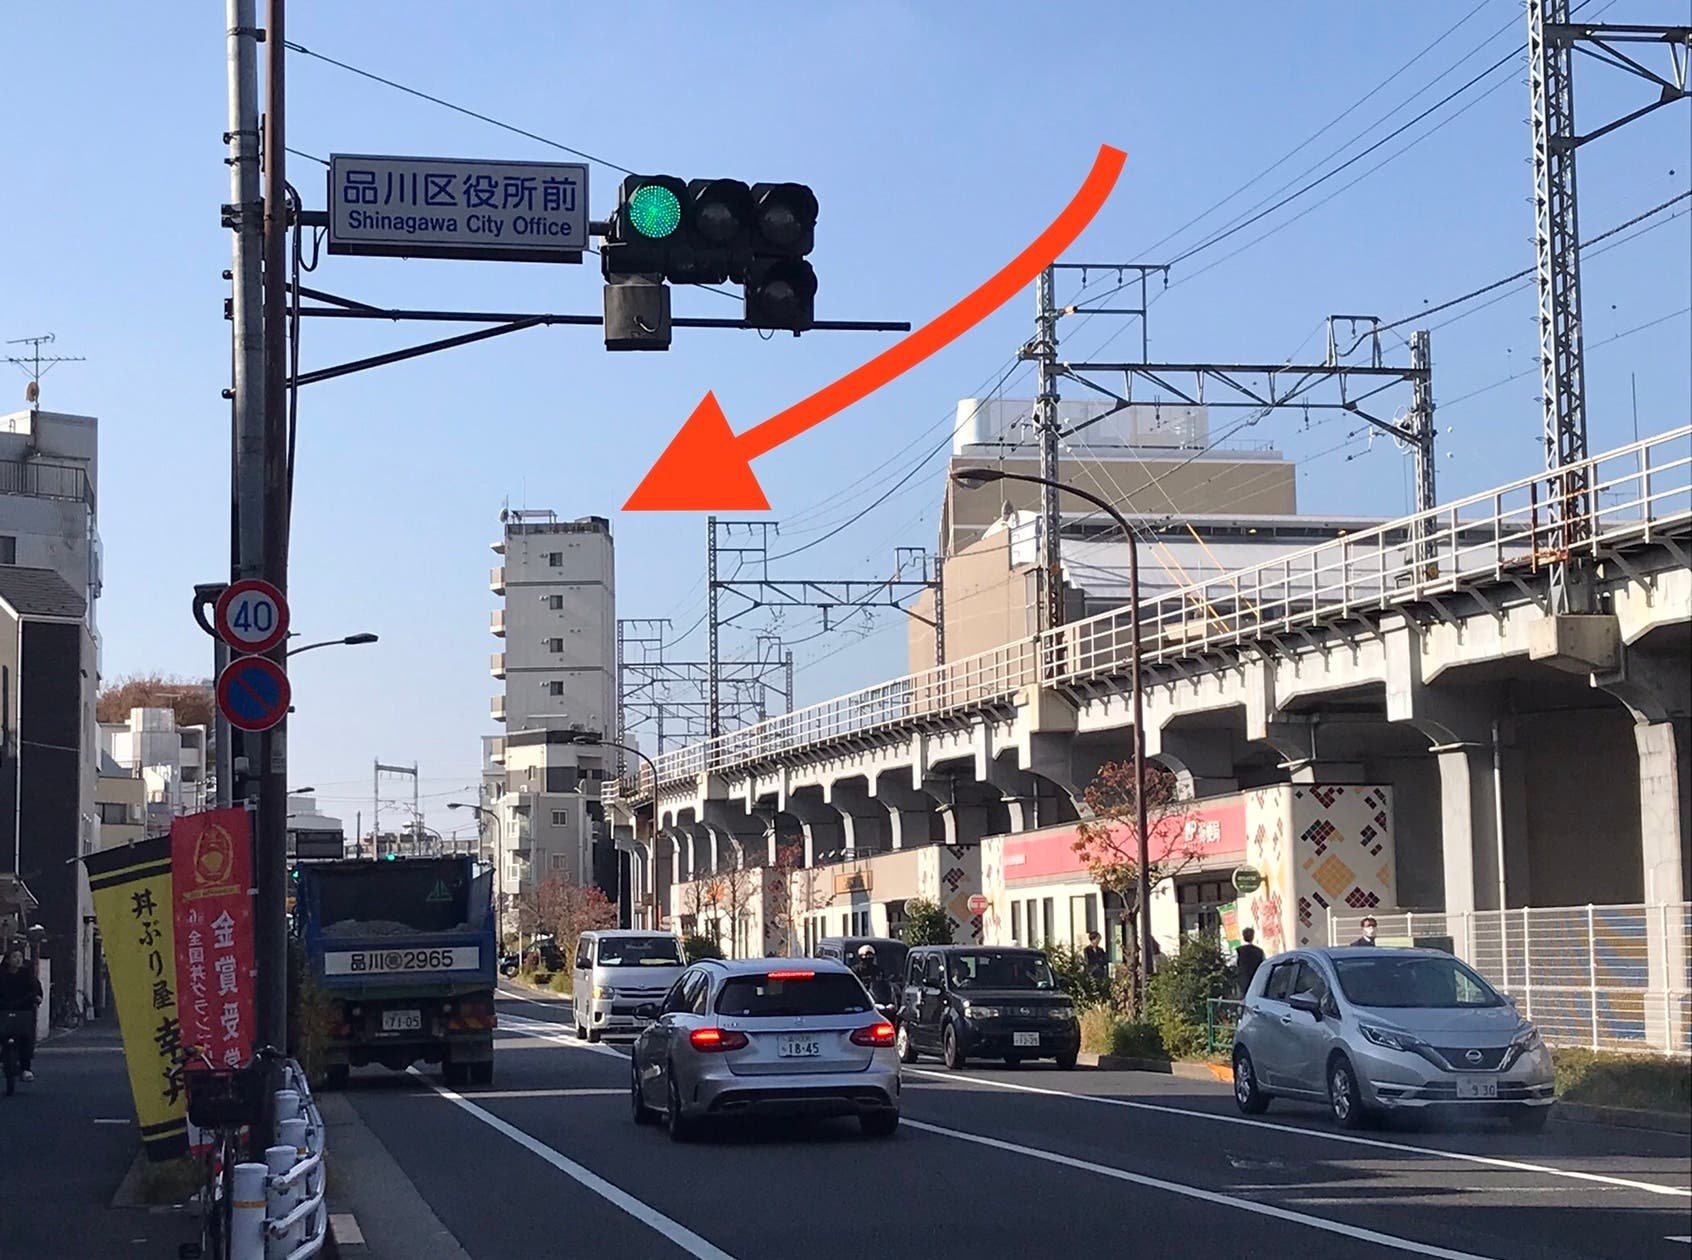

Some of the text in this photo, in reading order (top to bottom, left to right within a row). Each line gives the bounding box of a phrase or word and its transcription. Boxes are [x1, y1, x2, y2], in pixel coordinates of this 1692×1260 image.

[344, 170, 577, 212] 品川区役所前
[348, 210, 572, 237] Shinagawa City Office
[233, 600, 273, 632] 40
